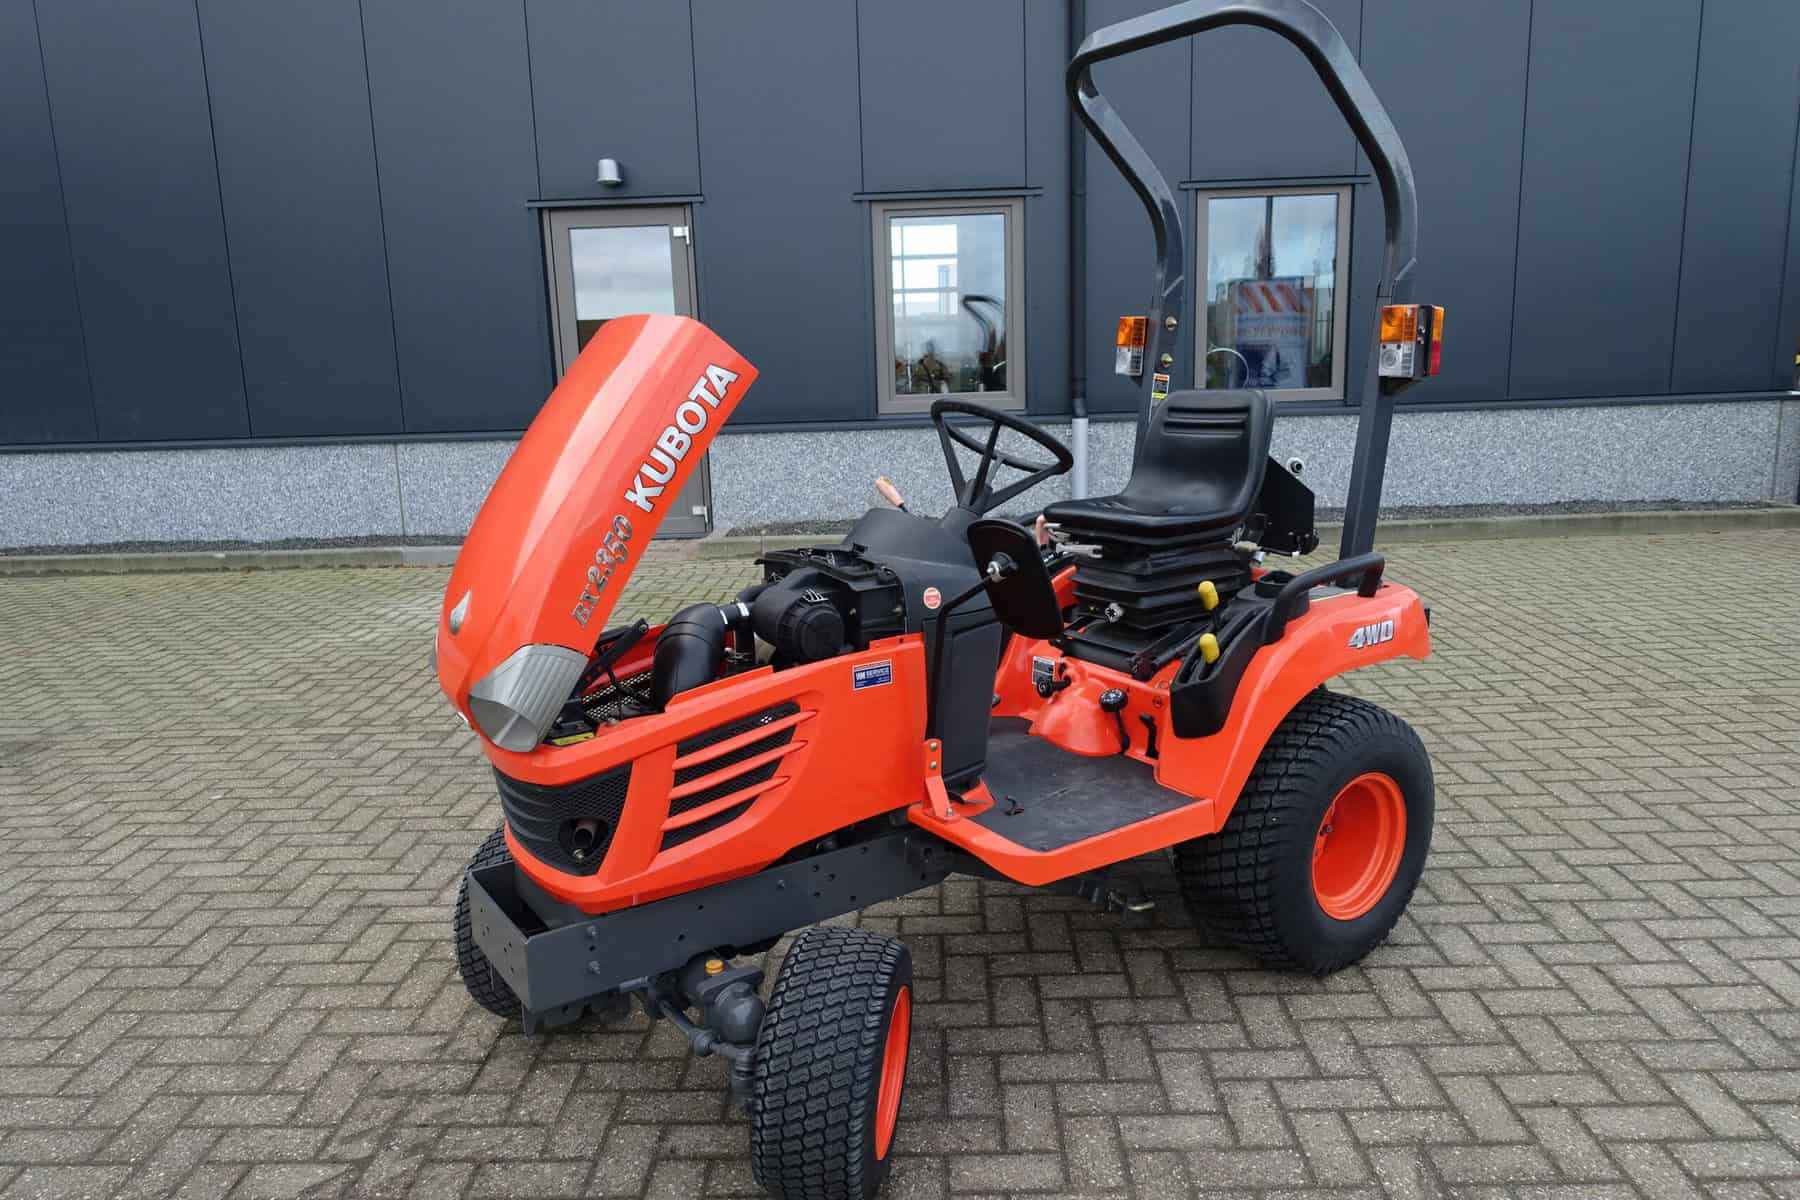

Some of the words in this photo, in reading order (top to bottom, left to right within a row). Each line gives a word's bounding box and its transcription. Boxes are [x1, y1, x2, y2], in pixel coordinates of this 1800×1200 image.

[624, 363, 739, 512] KUBOTA
[571, 514, 633, 629] BX2350
[1347, 619, 1395, 649] 4WD
